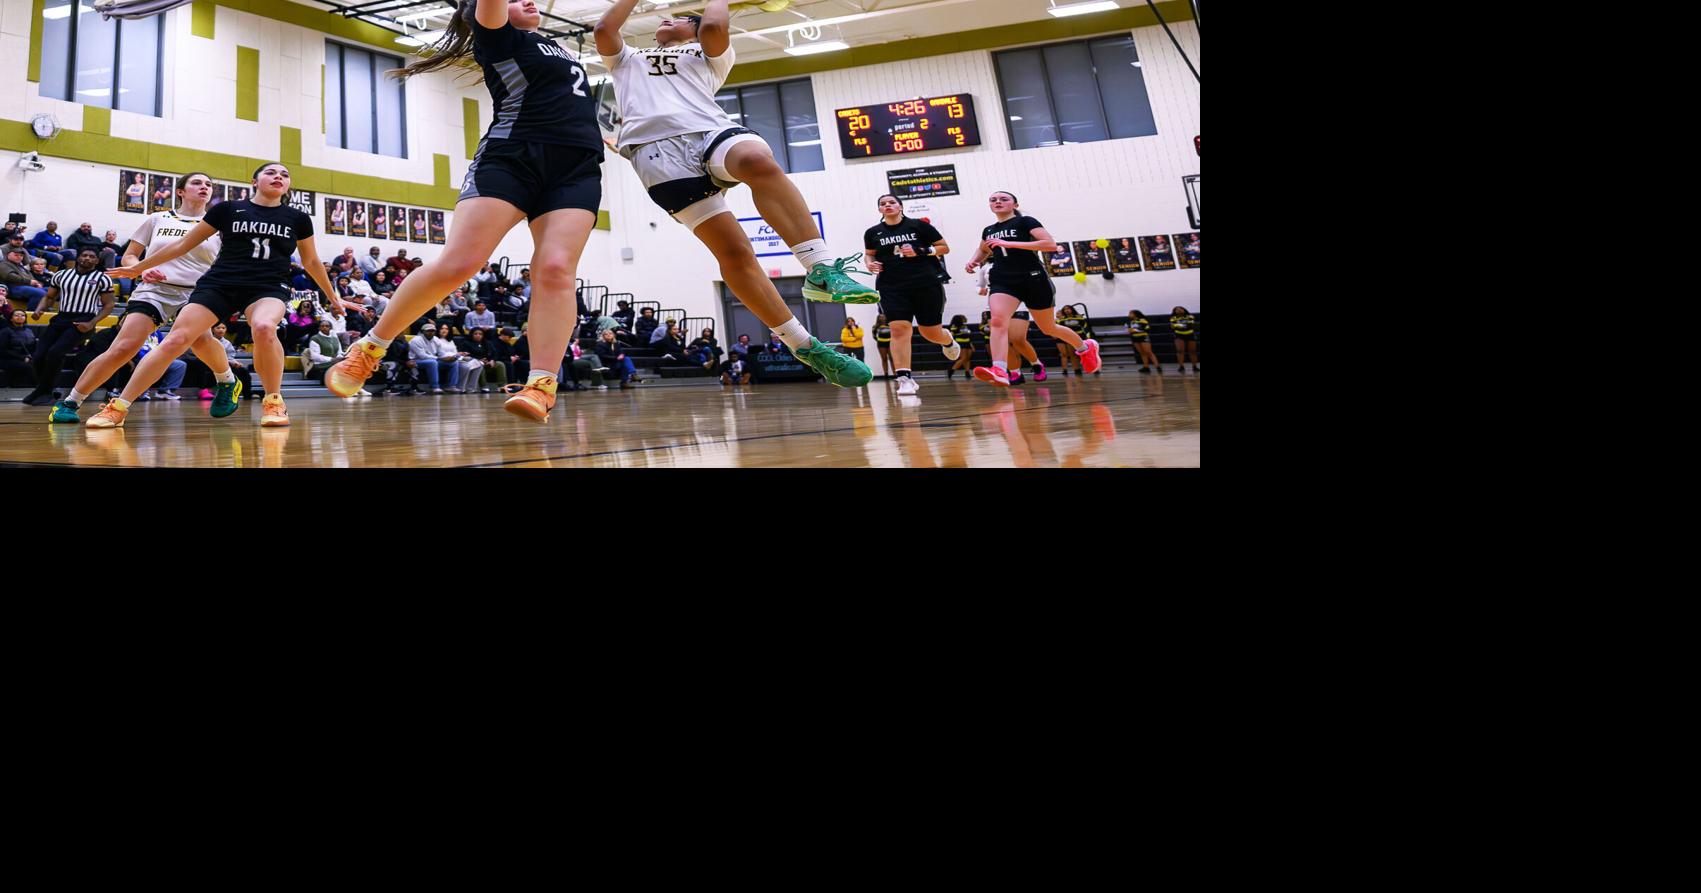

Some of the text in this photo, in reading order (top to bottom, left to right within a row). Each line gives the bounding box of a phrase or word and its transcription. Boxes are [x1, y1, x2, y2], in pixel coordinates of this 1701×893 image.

[646, 55, 678, 76] 35
[571, 65, 587, 97] 2
[888, 100, 926, 116] 4:26
[948, 104, 964, 118] 13
[849, 115, 870, 130] 20
[920, 118, 929, 130] 2
[893, 139, 923, 152] 0-00
[955, 134, 965, 145] 2
[866, 145, 871, 154] 1
[290, 190, 310, 204] ME
[232, 221, 292, 238] OAKDALE
[880, 232, 917, 246] OAKDALE
[251, 237, 270, 260] 11
